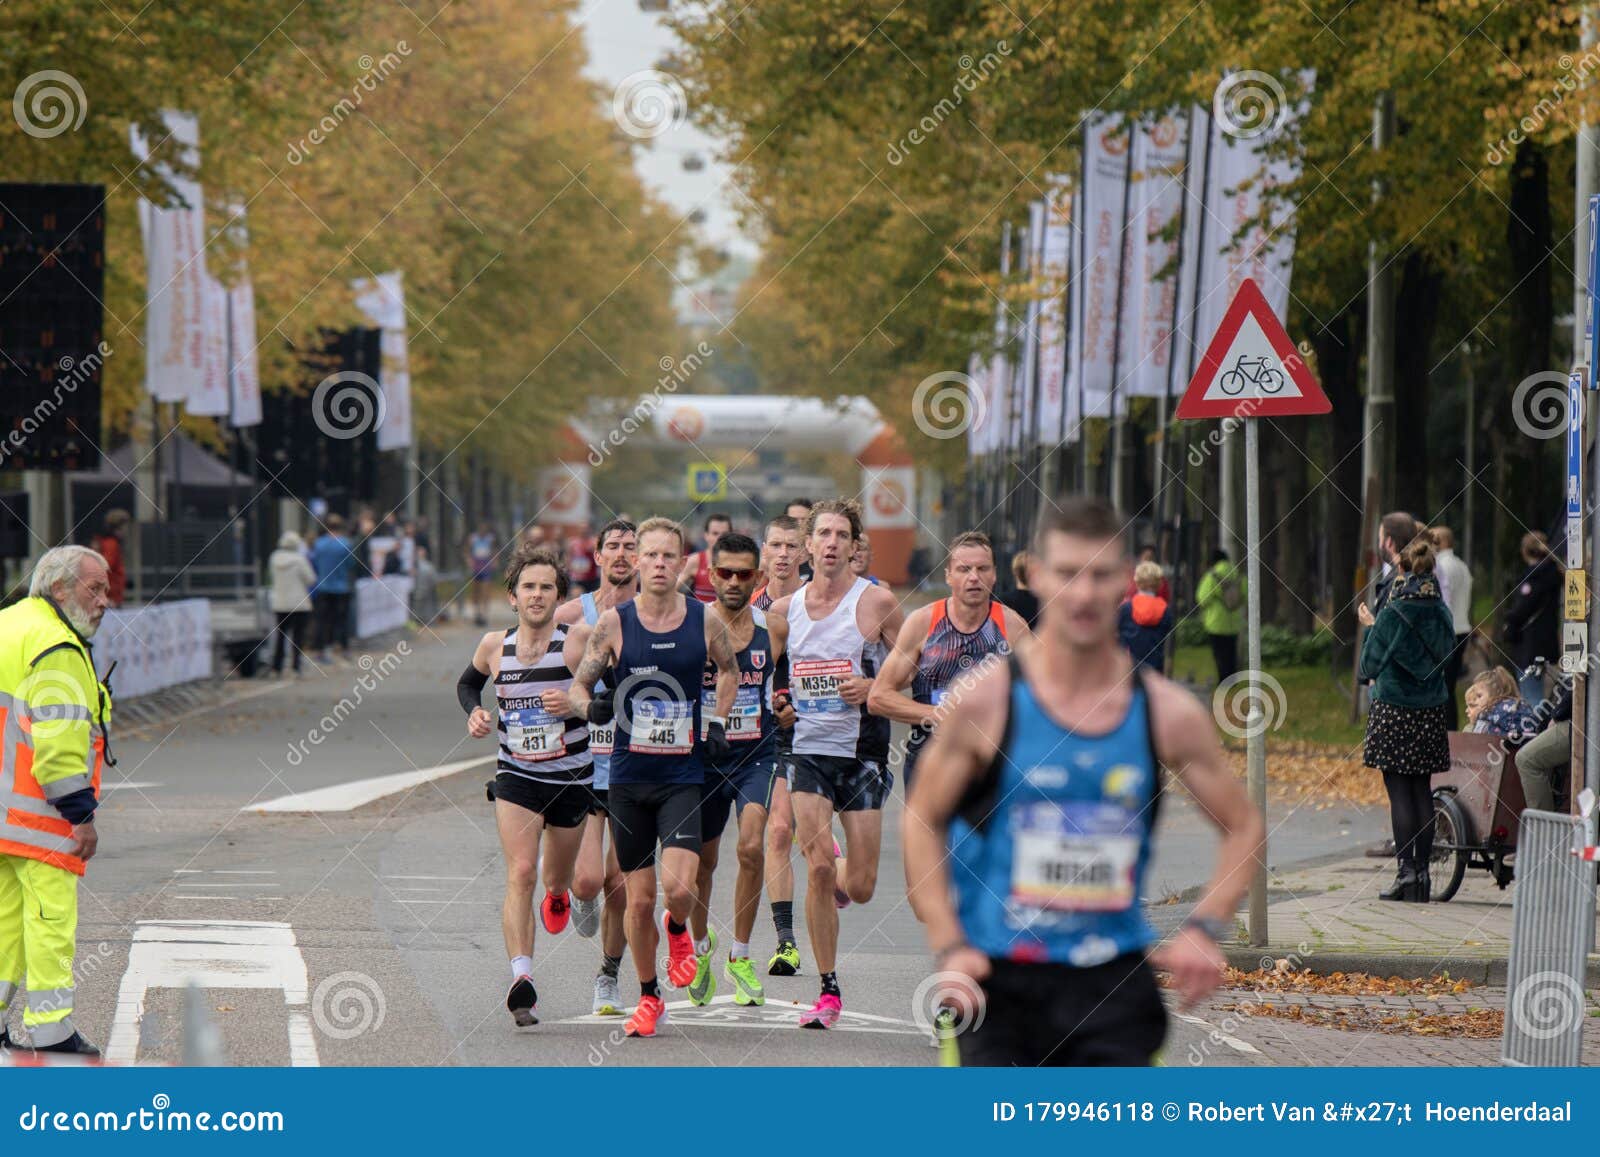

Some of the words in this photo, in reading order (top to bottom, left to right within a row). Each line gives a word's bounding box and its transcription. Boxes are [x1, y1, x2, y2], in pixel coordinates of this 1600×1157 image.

[501, 672, 523, 682] soar
[702, 671, 764, 686] CAIARI
[505, 697, 544, 710] HIGHG
[522, 734, 547, 751] 431
[648, 728, 675, 744] 445
